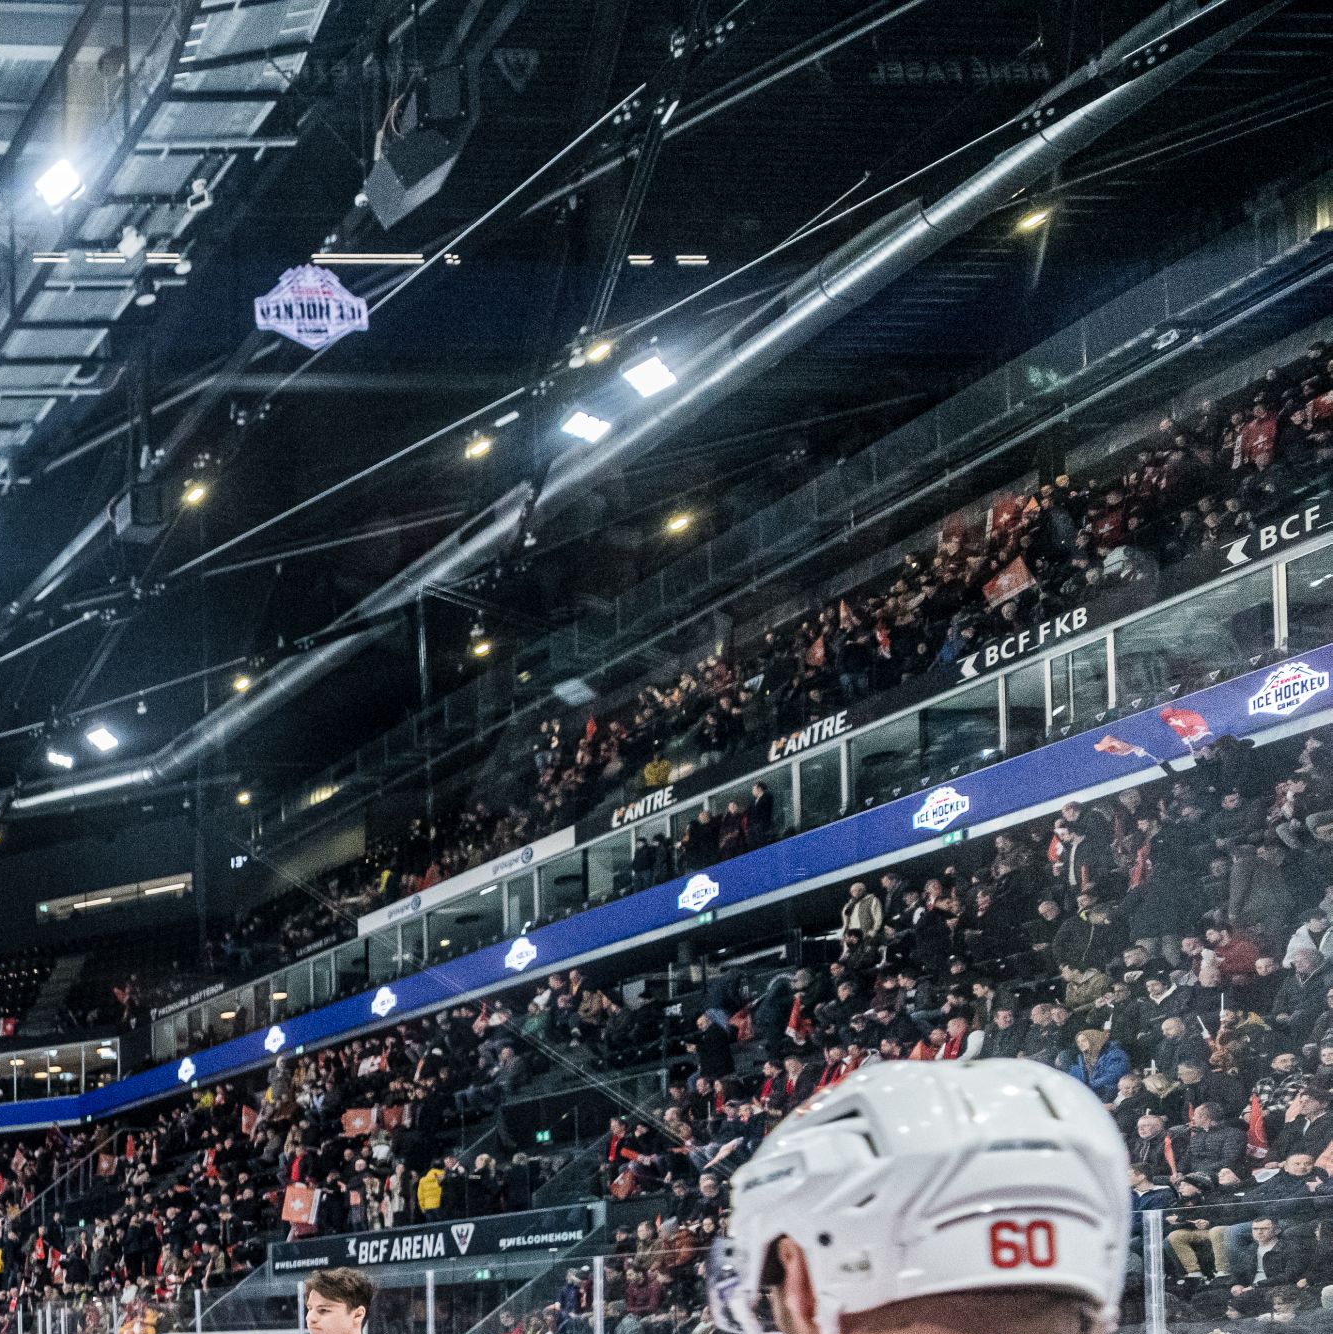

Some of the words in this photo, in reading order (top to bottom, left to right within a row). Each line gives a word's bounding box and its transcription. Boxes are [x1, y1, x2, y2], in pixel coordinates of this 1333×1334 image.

[1260, 505, 1321, 551] BCF
[985, 630, 1031, 668] BCF
[1039, 607, 1088, 646] FKB
[1253, 691, 1272, 710] ICE
[1275, 675, 1325, 703] HOCKEY
[917, 810, 930, 824] ICE
[358, 1238, 390, 1265] BCF
[390, 1232, 445, 1262] ARENA
[989, 1220, 1057, 1269] 60
